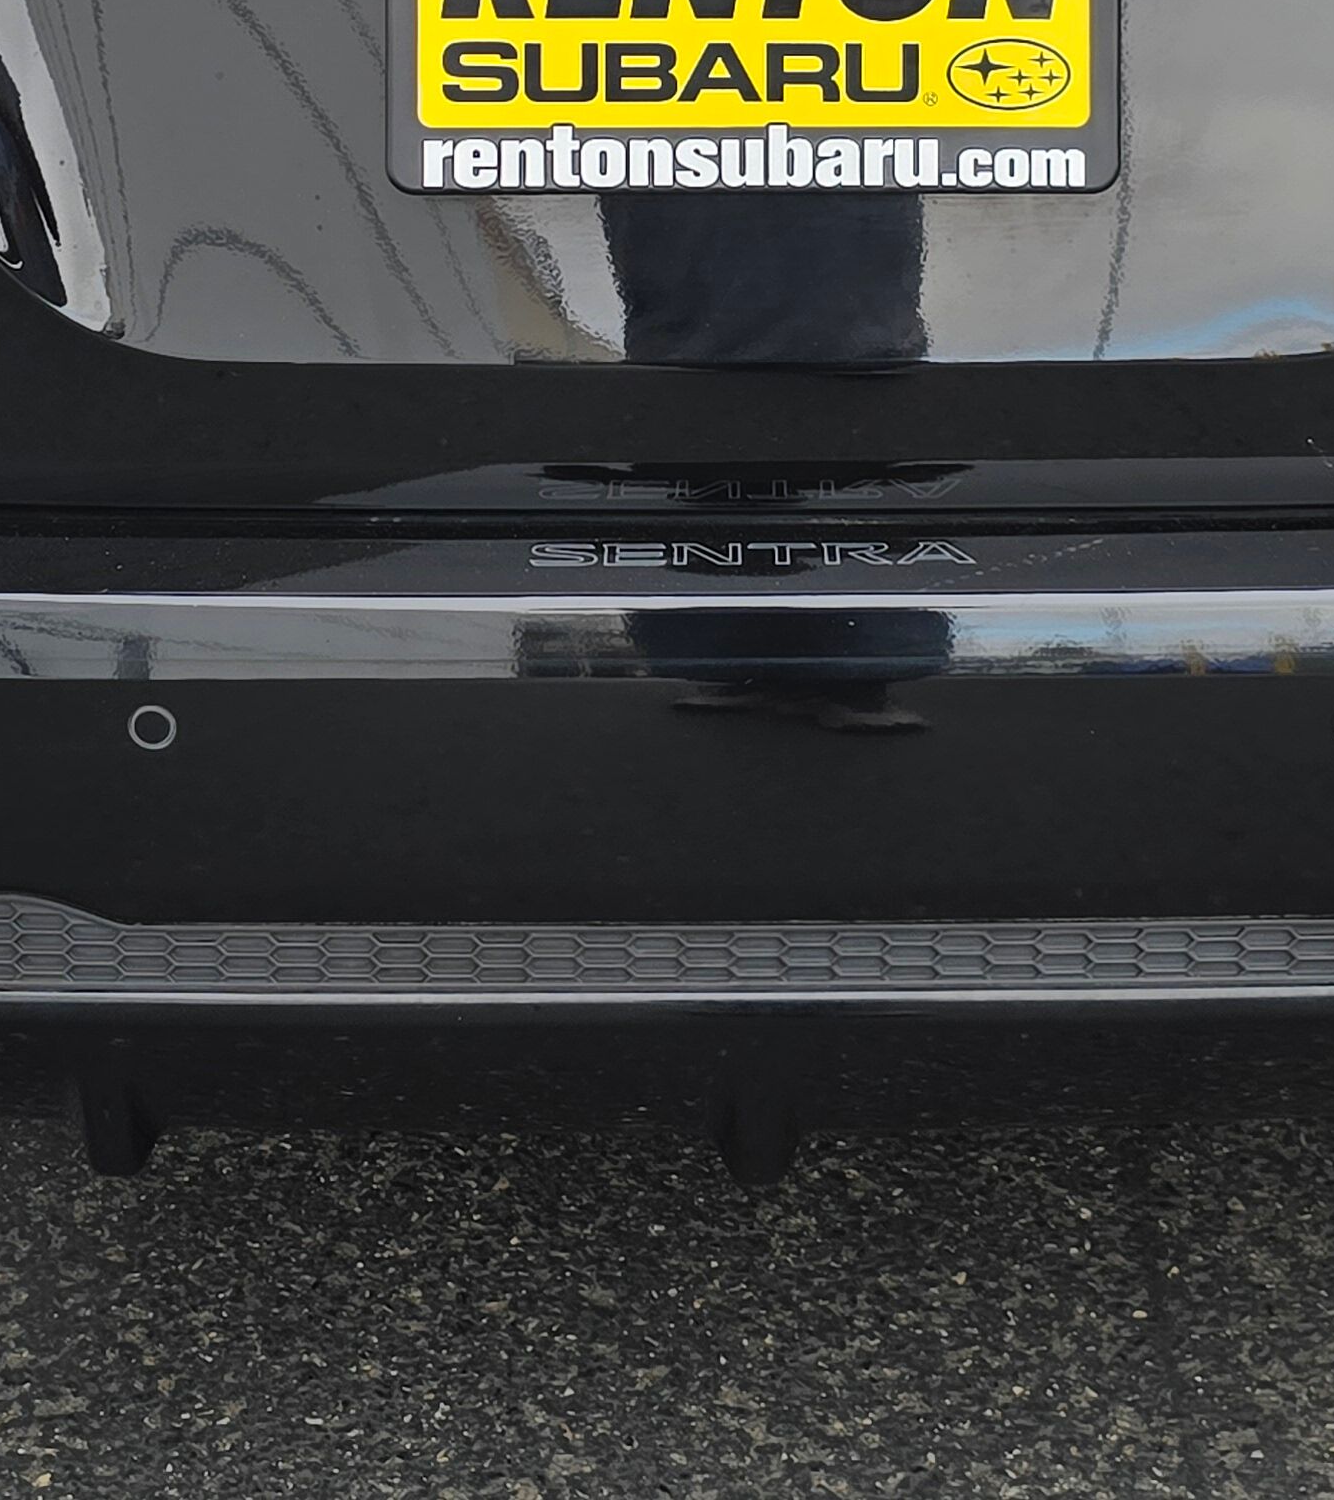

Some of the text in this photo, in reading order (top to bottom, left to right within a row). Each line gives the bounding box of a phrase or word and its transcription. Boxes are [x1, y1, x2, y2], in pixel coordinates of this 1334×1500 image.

[441, 41, 920, 103] SUBARU
[421, 124, 1087, 188] rentonsubaru.com
[529, 541, 977, 568] SENTRA
